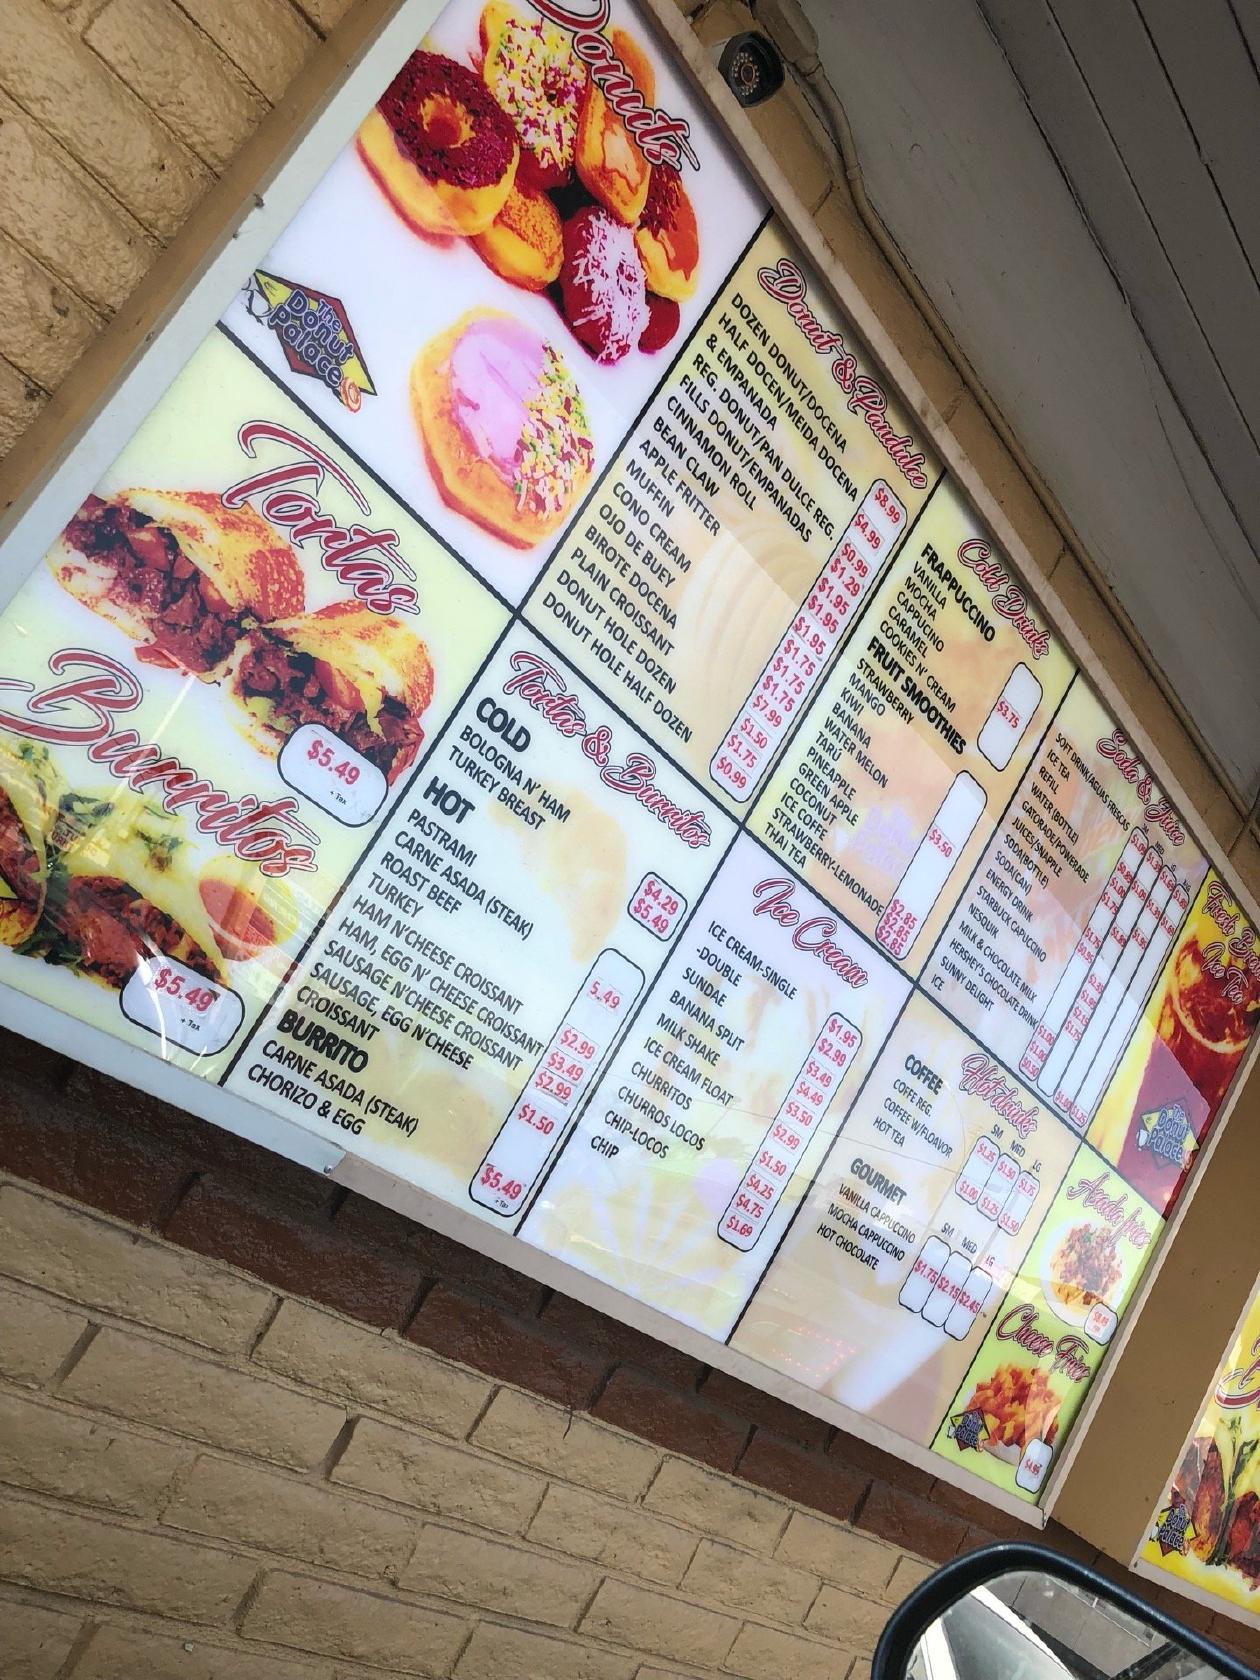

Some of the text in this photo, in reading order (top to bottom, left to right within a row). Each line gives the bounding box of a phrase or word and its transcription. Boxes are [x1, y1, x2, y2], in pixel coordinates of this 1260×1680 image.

[286, 288, 355, 363] Donut
[316, 299, 342, 334] The
[268, 302, 343, 387] Palace
[706, 333, 777, 431] & EMPANADA
[731, 292, 847, 454] DOZEN DONUT/DOCENA
[757, 258, 927, 489] Donut & Pandulce
[718, 312, 858, 502] HALF DOCEN/MEIDA DOCENA
[653, 416, 720, 497] BEAN CLAW
[667, 396, 756, 511] CINNAMON ROLL
[679, 374, 812, 542] FILLS DONUT/EMPANADAS
[692, 353, 835, 541] REG. DONUT/PAN DULCE REG.
[626, 459, 675, 518] MUFFIN
[639, 439, 720, 536] APPLE FRITTER
[874, 487, 900, 524] $8.99
[221, 420, 420, 615] Tortas
[613, 482, 692, 573] CONO CREAM
[854, 514, 881, 549] $4.99
[584, 524, 677, 630] BIROTE DOCENA
[830, 558, 860, 597] $1.29
[841, 543, 868, 578] $0.99
[913, 561, 947, 610] VANILLA
[570, 547, 675, 656] PLAIN CROISSANT
[904, 576, 937, 621] MOCHA
[921, 542, 996, 642] FRAPPUCCINO
[958, 539, 1051, 660] Cold Drinks
[888, 605, 928, 658] CARAMEL
[897, 591, 944, 652] CAPPUCINO
[857, 658, 915, 725] STRAWBERRY
[880, 620, 956, 713] COOKIES N' CREAM
[753, 694, 782, 727] $7.99
[840, 687, 864, 716] KIWI
[848, 672, 886, 716] MANGO
[867, 635, 967, 755] FRUIT SMOOTHIES
[997, 701, 1020, 728] $3.75
[476, 697, 531, 753] COLD
[503, 650, 711, 849] Tortas & Burritos
[740, 718, 768, 749] $1.50
[824, 716, 889, 788] WATER MELON
[832, 702, 871, 749] BANANA
[0, 648, 320, 877] Burritos
[307, 739, 361, 785] $5.49
[449, 745, 546, 830] TURKEY BREAST
[459, 724, 571, 823] BOLOGNA N' HAM
[806, 746, 856, 801] PINEAPPLE
[1039, 766, 1059, 795] REFILL
[1136, 773, 1152, 805] &
[423, 776, 476, 824] HOT
[790, 777, 837, 826] COCONUT
[1031, 781, 1079, 846] WATER (BOTTLE)
[407, 808, 477, 867] PASTRAMI
[929, 829, 952, 858] $3.50
[1011, 816, 1063, 878] JUICES/SNAPPLE
[368, 872, 424, 918] TURKEY
[380, 851, 462, 914] ROAST BEEF
[395, 831, 534, 941] CARNE ASADA (STEAK)
[644, 880, 679, 915] $4.29
[995, 850, 1033, 896] SODA(CAN)
[633, 898, 669, 933] $5.49
[752, 878, 869, 989] Ice Cream
[968, 903, 999, 939] NESQUIK
[976, 885, 1047, 962] STARBUCK CAPUCCINO
[352, 894, 393, 929] HAM
[453, 962, 524, 1015] CROISSANT
[708, 920, 797, 1000] ICE CREAM-SINGLE
[154, 966, 213, 1012] $5.49
[310, 962, 380, 1017] SAUSAGE,
[381, 1004, 413, 1033] EGG
[682, 967, 727, 1007] SUNDAE
[931, 973, 945, 991] ICE
[297, 985, 380, 1041] CROISSANT
[656, 1012, 721, 1067] MILK SHAKE
[669, 990, 745, 1051] BANANA SPLIT
[828, 1018, 857, 1048] $1.95
[276, 1009, 369, 1073] BURRITO
[547, 1051, 584, 1081] $3.49
[248, 1064, 366, 1135] CHORIZO & EGG
[631, 1061, 692, 1110] CHURRITOS
[806, 1060, 832, 1088] $3.49
[893, 1079, 933, 1117] COFFE REG.
[904, 1054, 944, 1095] COFFEE
[518, 1103, 555, 1135] $1.50
[605, 1110, 669, 1159] CHIP-LOCOS
[618, 1086, 706, 1151] CHURROS LOCOS
[785, 1101, 813, 1126] $3.50
[591, 1135, 619, 1159] CHIP
[481, 1166, 522, 1200] $5.49
[736, 1194, 764, 1219] $4.75
[746, 1174, 774, 1200] $4.25
[850, 1158, 907, 1206] GOURMET
[827, 1203, 905, 1261] MOCHA CAPPUCCINO
[914, 1260, 939, 1284] $1.75
[937, 1276, 960, 1299] $2.15
[958, 1291, 980, 1314] $2.45
[996, 1303, 1054, 1357] Cheese
